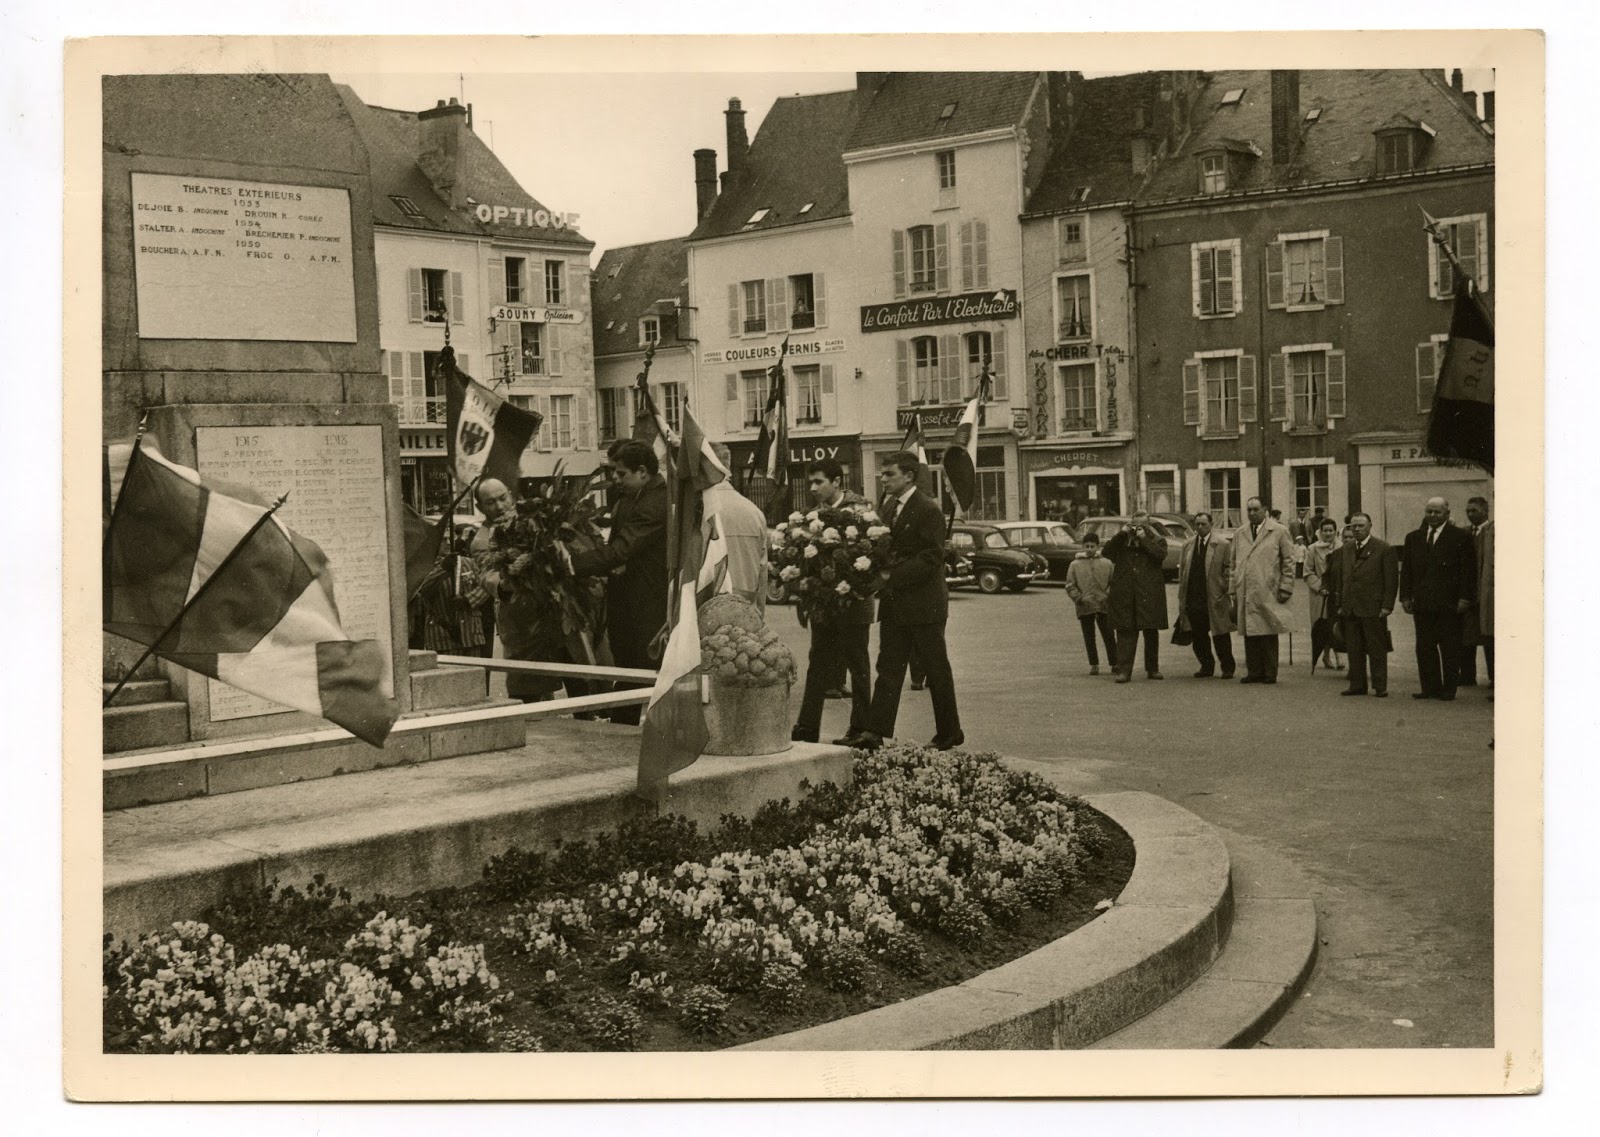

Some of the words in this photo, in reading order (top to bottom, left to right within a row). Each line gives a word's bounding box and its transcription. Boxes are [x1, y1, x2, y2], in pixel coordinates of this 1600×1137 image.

[476, 204, 581, 230] OPTIQUE
[246, 251, 274, 259] FROC
[499, 308, 536, 320] SOUNY
[544, 310, 575, 323] Opticien
[876, 304, 920, 327] Confort
[922, 302, 942, 321] Par
[725, 346, 777, 361] COULEURS
[783, 342, 821, 356] ERNIS
[1046, 345, 1104, 360] CHERRT
[1034, 361, 1048, 433] KODAK
[899, 410, 944, 426] Msset
[789, 446, 840, 463] LLOY
[1054, 452, 1099, 463] CHERRET
